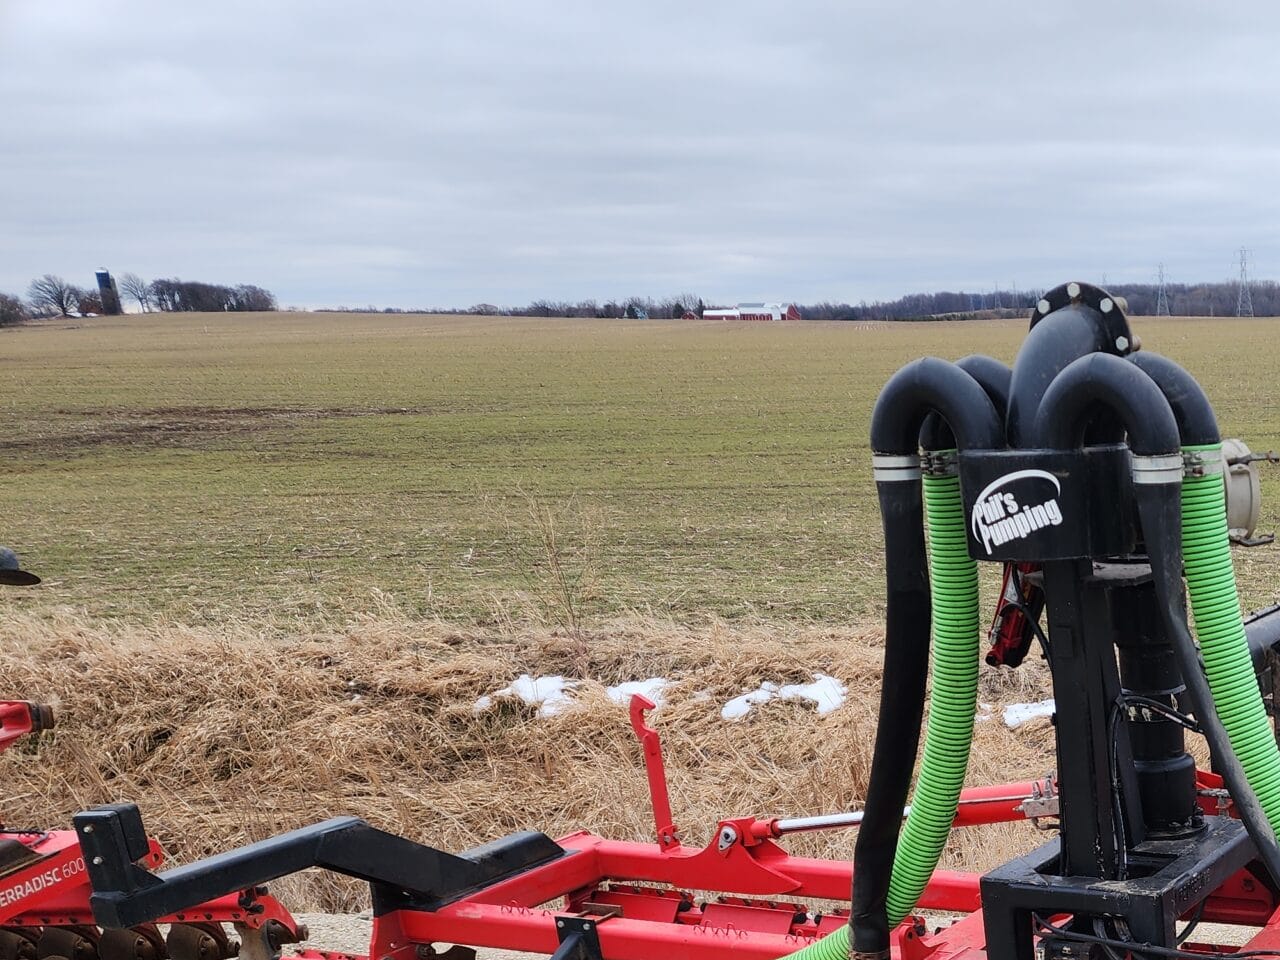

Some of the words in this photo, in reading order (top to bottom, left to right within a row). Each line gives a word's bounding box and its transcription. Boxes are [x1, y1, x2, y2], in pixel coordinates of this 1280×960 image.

[974, 492, 1018, 524] Phil's
[981, 499, 1063, 555] Pumping
[0, 867, 62, 908] ERRADISC
[62, 857, 85, 878] 600
